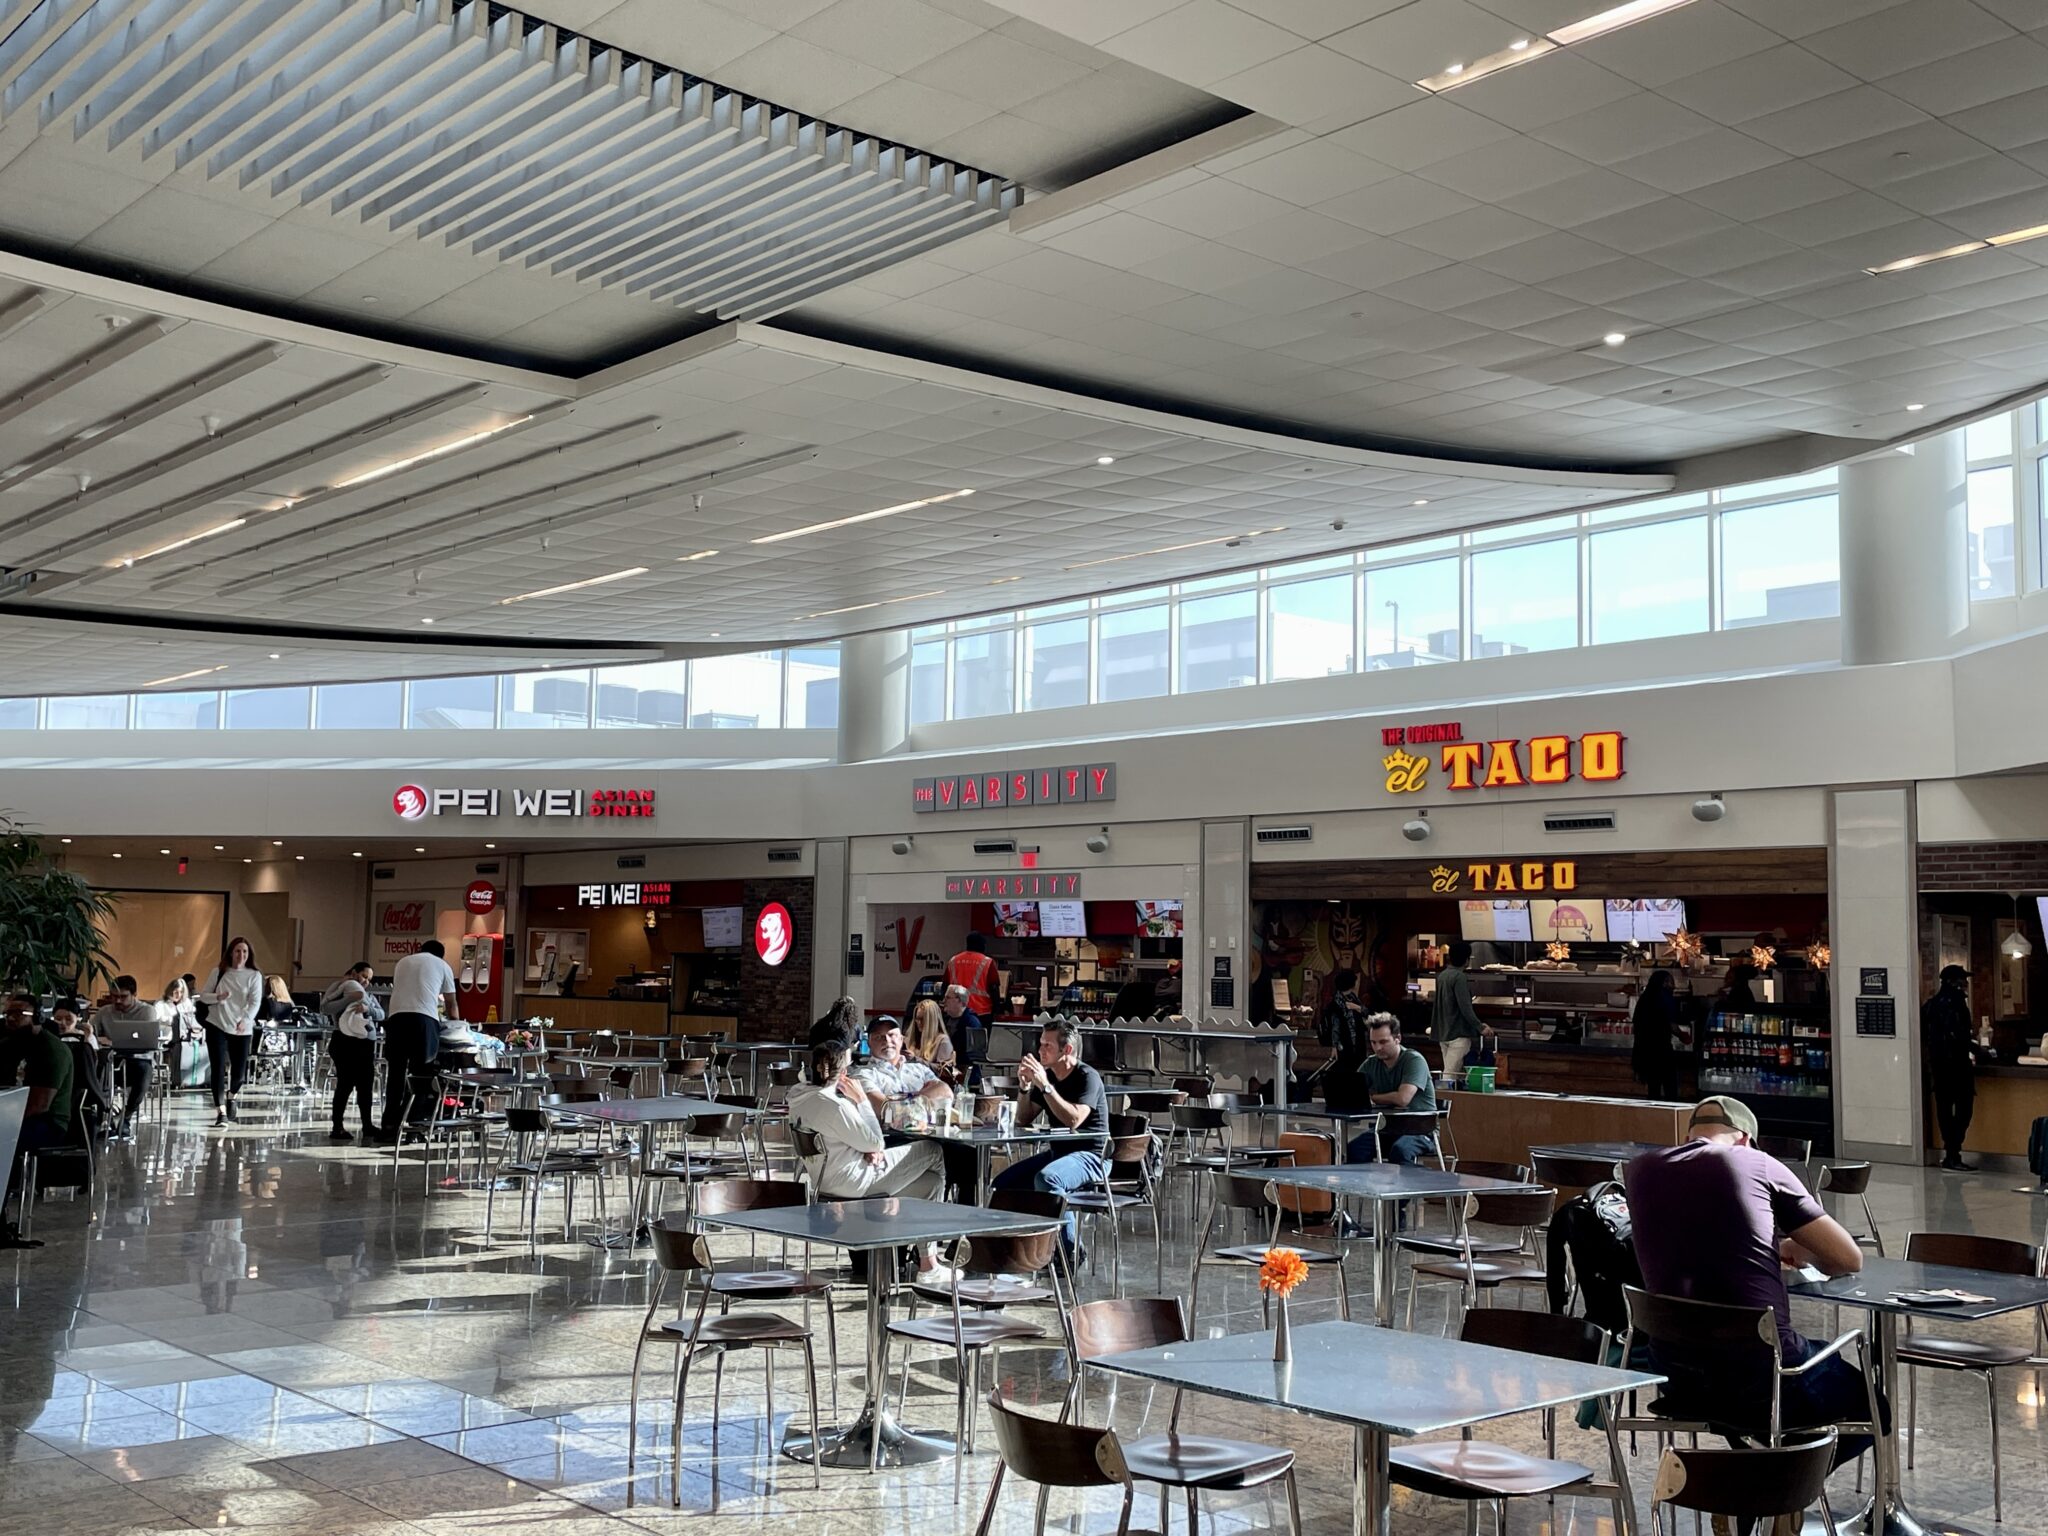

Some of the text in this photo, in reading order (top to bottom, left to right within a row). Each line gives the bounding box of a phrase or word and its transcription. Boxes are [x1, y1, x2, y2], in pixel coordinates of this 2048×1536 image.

[1382, 722, 1463, 746] THE ORIGINAL
[1442, 731, 1627, 790] TACO
[590, 789, 654, 801] ASIAN
[915, 768, 1108, 804] THE VARSITY
[432, 788, 583, 816] PEI WEI
[589, 805, 654, 817] DINER
[643, 883, 671, 892] ASIAN
[964, 876, 1078, 895] VARSITY
[1431, 861, 1578, 893] el TACO
[578, 884, 641, 906] PEI WEI
[642, 895, 670, 905] DINER
[896, 915, 926, 973] V
